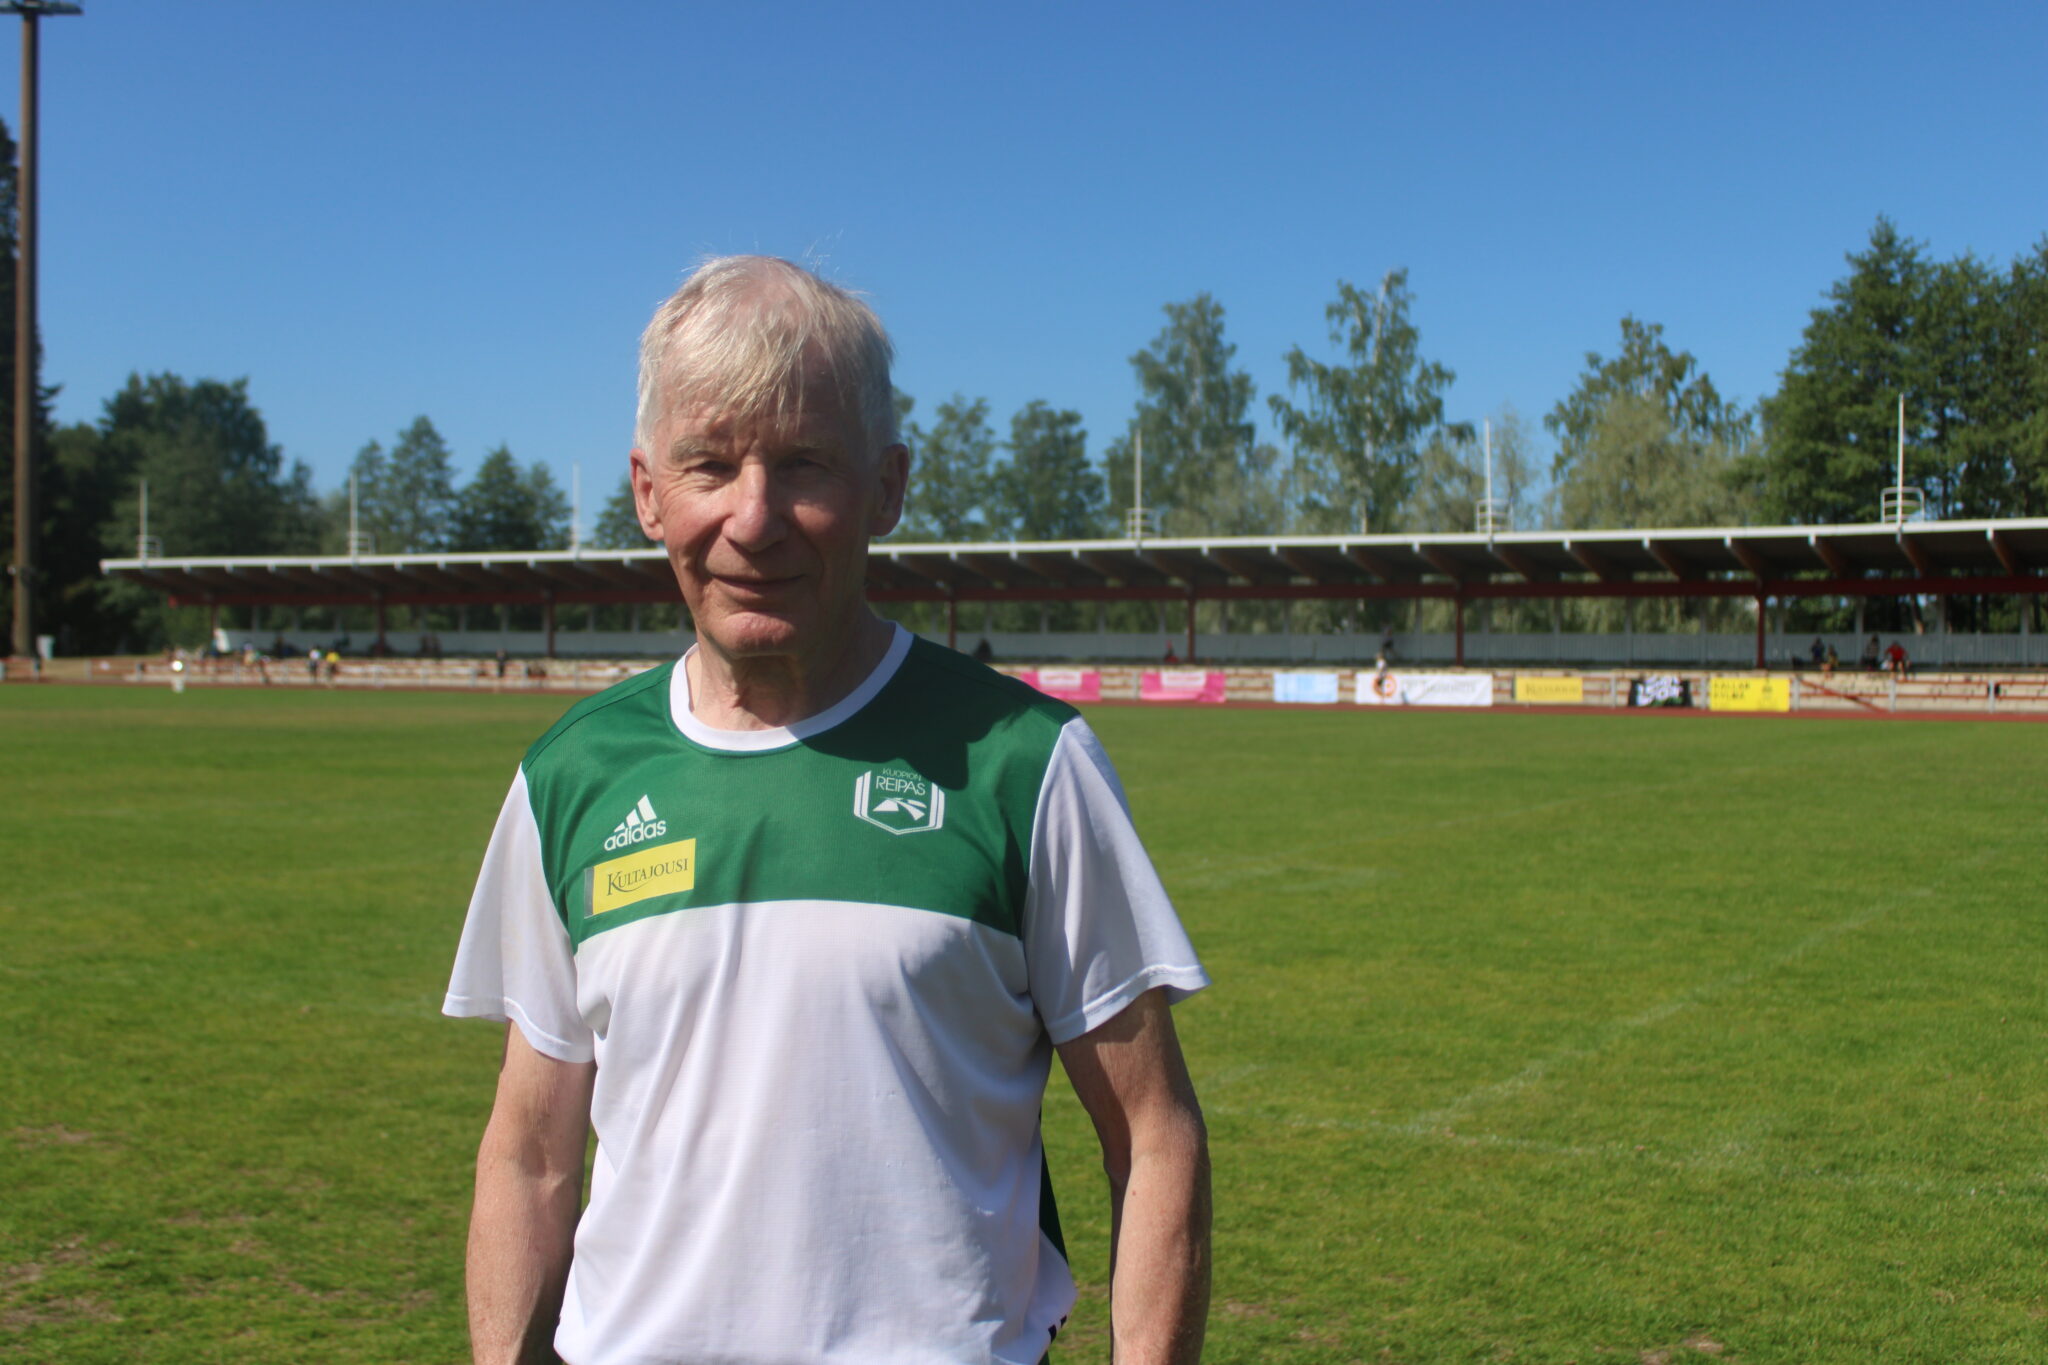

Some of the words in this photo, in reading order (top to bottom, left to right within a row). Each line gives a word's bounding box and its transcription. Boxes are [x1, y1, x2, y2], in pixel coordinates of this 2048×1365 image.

[875, 775, 926, 796] REIPAS
[604, 820, 666, 851] adidas
[607, 858, 688, 896] KULTAJOUSI
